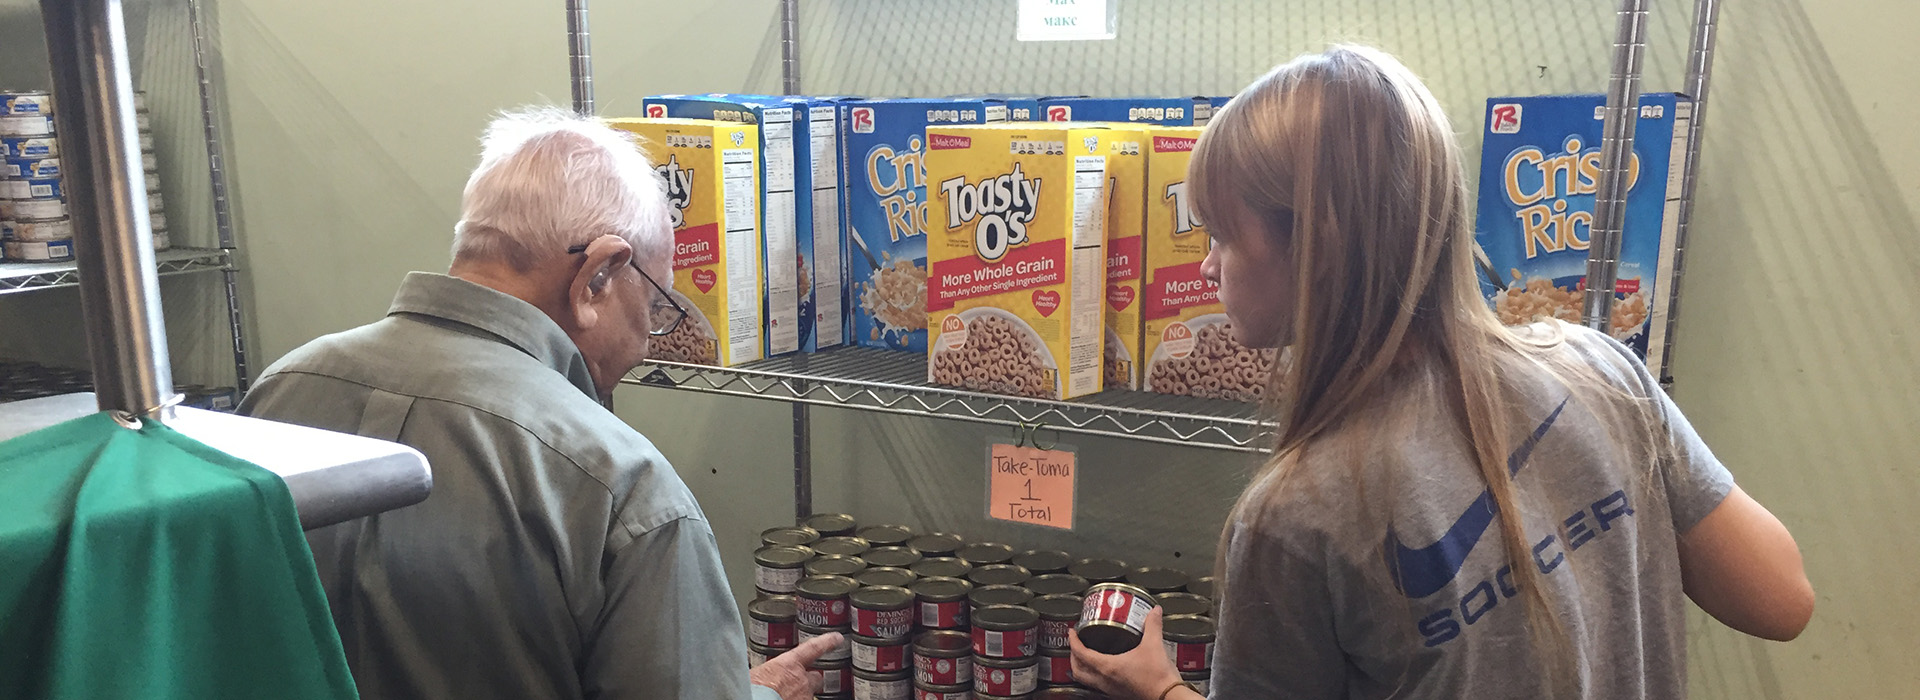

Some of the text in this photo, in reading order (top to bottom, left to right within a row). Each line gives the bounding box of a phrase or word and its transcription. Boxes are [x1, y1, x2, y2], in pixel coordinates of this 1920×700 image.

[868, 138, 927, 196] Cri
[1505, 138, 1640, 206] Cris
[941, 162, 1042, 229] Toasty
[1516, 199, 1591, 259] Ric
[676, 239, 709, 255] Grain
[678, 254, 712, 266] Ingredient
[1107, 253, 1128, 268] ain
[942, 257, 1054, 287] More Whole Grain
[940, 272, 1057, 299] Than Any Other Single Ingredient
[1165, 280, 1202, 295] More
[1035, 300, 1057, 308] Healthy
[1162, 291, 1218, 306] Than Any Oth
[945, 320, 960, 331] NO
[1168, 327, 1186, 339] NO
[1020, 479, 1041, 501] 1
[1009, 503, 1051, 521] Total
